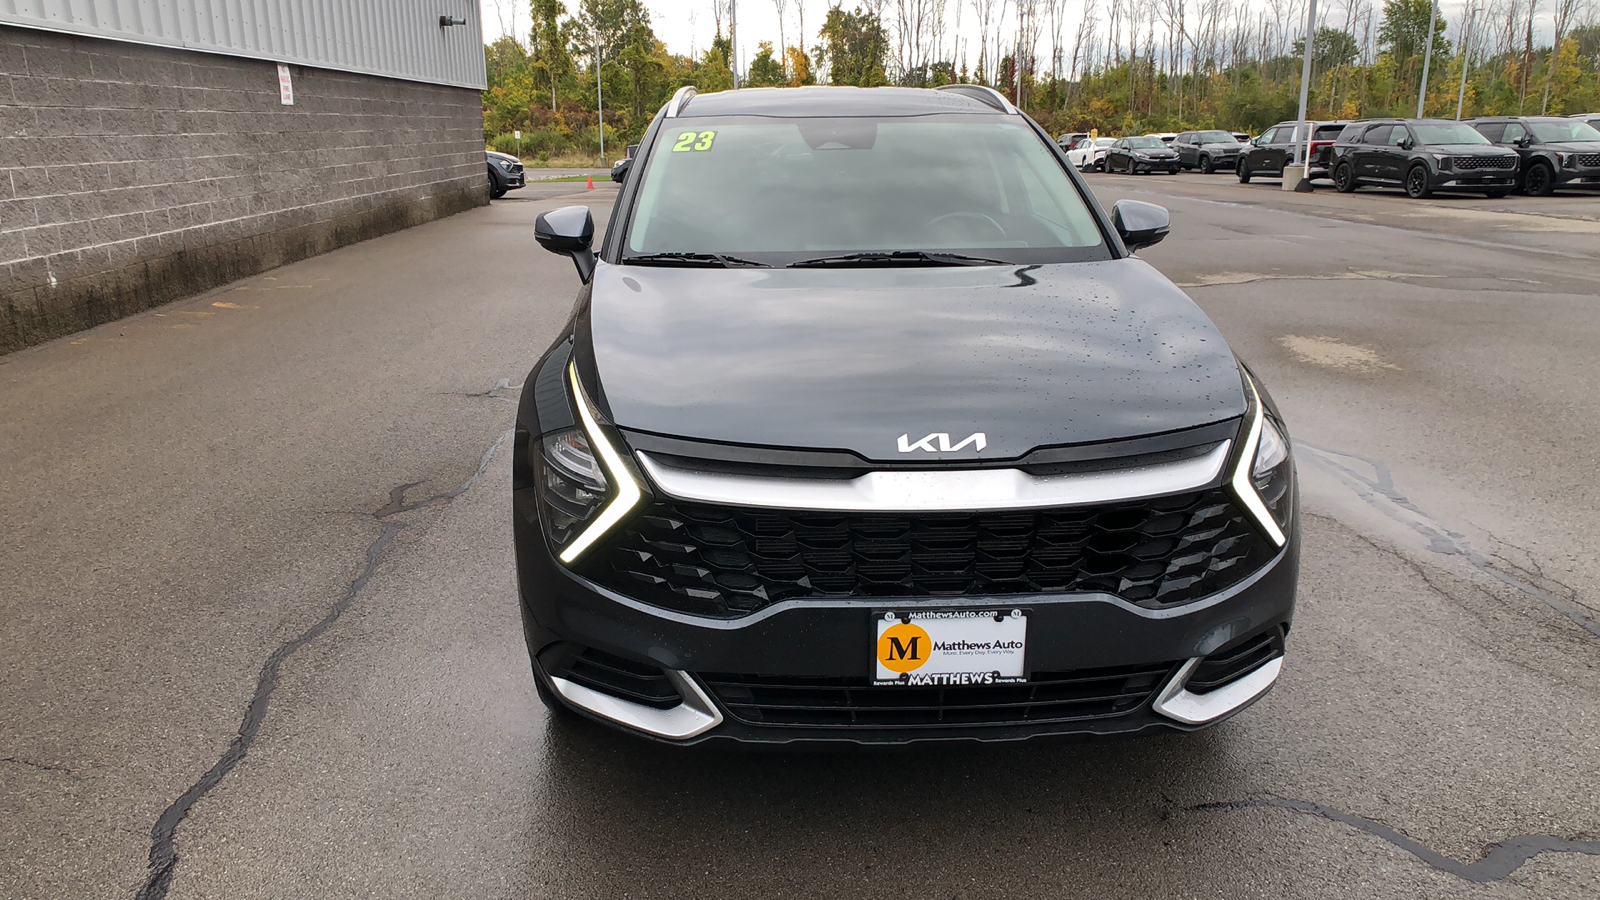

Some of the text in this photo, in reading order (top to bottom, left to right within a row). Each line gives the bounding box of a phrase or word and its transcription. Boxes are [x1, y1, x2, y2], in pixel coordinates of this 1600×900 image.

[672, 131, 716, 152] 23
[896, 432, 987, 453] KIA
[908, 610, 998, 619] MatthewsAuto.com
[885, 636, 922, 661] M
[933, 639, 1023, 651] Matthews Auto
[907, 672, 993, 686] MATTHEWS
